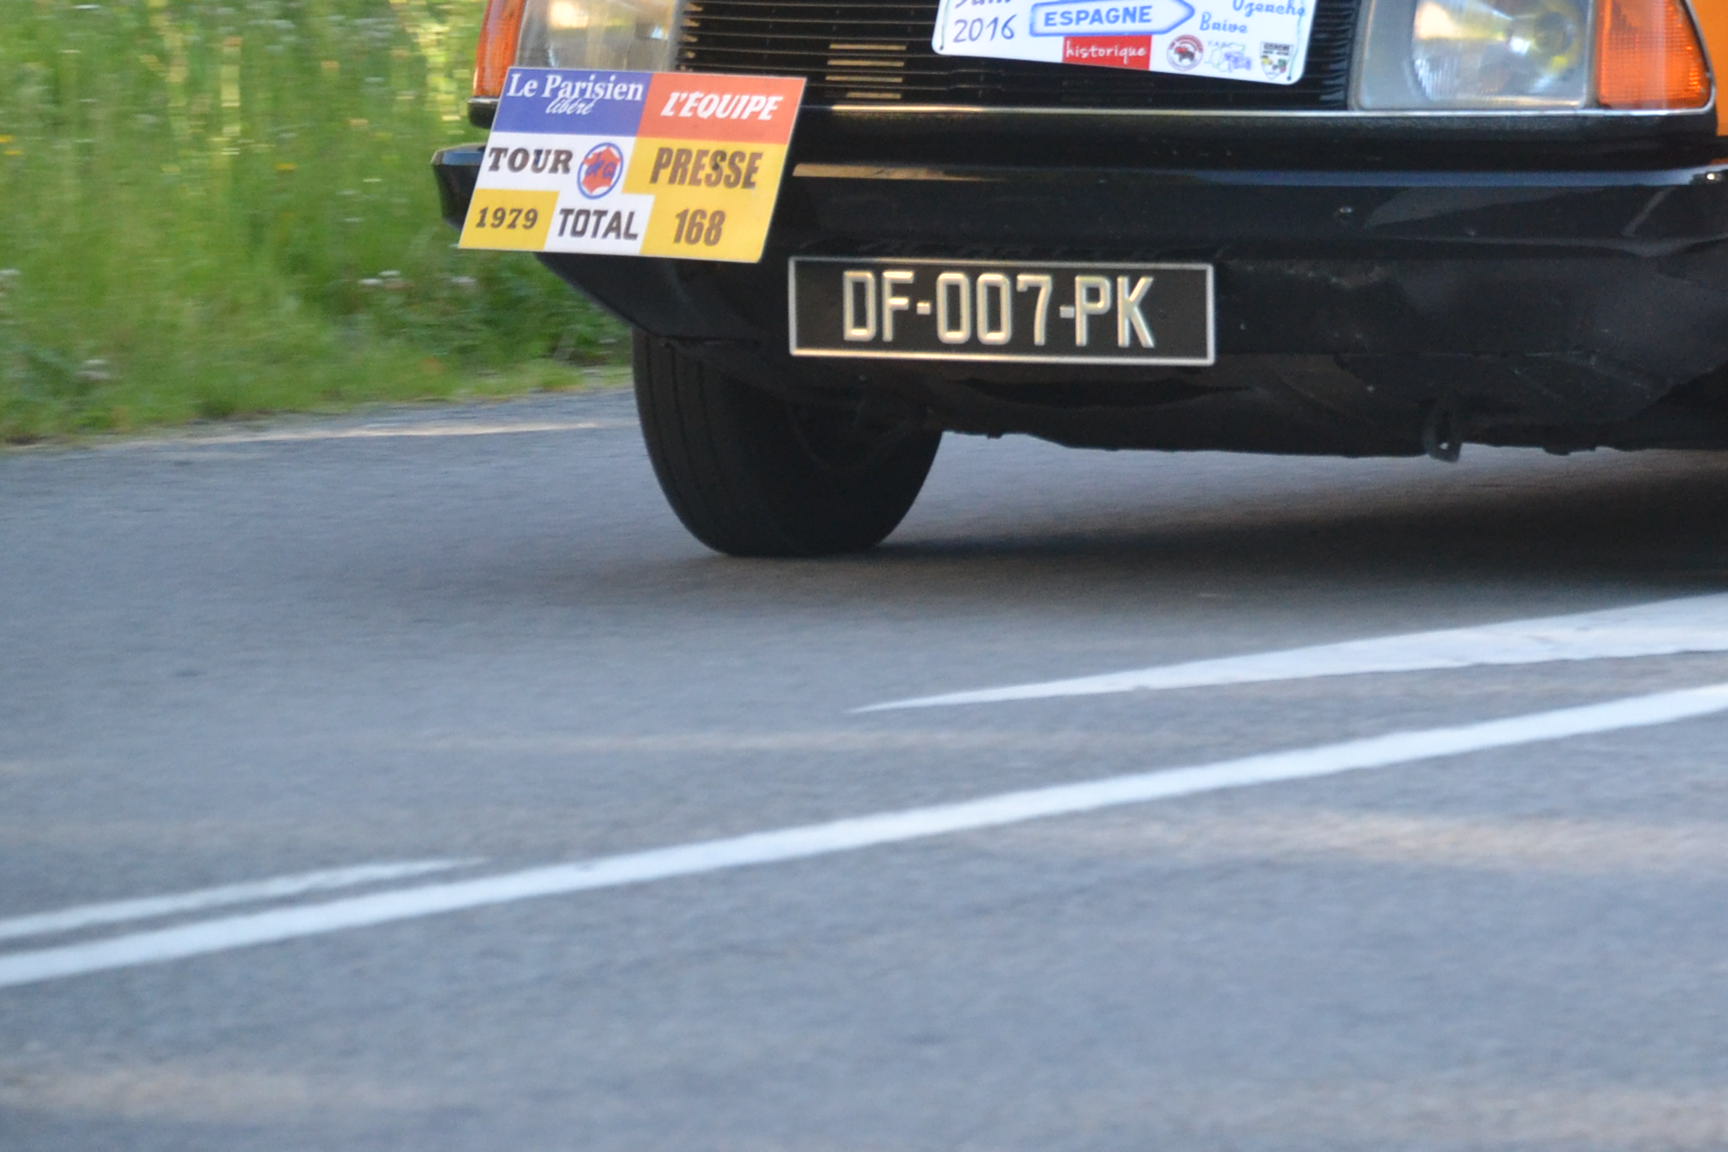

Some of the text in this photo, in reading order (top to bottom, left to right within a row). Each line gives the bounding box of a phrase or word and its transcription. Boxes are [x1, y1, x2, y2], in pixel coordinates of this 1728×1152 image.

[953, 14, 1016, 43] 2016
[1043, 4, 1154, 28] ESPAGNE
[1200, 11, 1248, 34] Brive
[1065, 40, 1148, 65] historique
[506, 73, 643, 101] Le Parisien
[487, 147, 574, 175] TOUR
[649, 147, 763, 190] PRESSE
[475, 206, 539, 230] 1979
[558, 208, 639, 240] TOTAL
[673, 209, 726, 246] 168
[842, 269, 1156, 348] DF-007-PK
